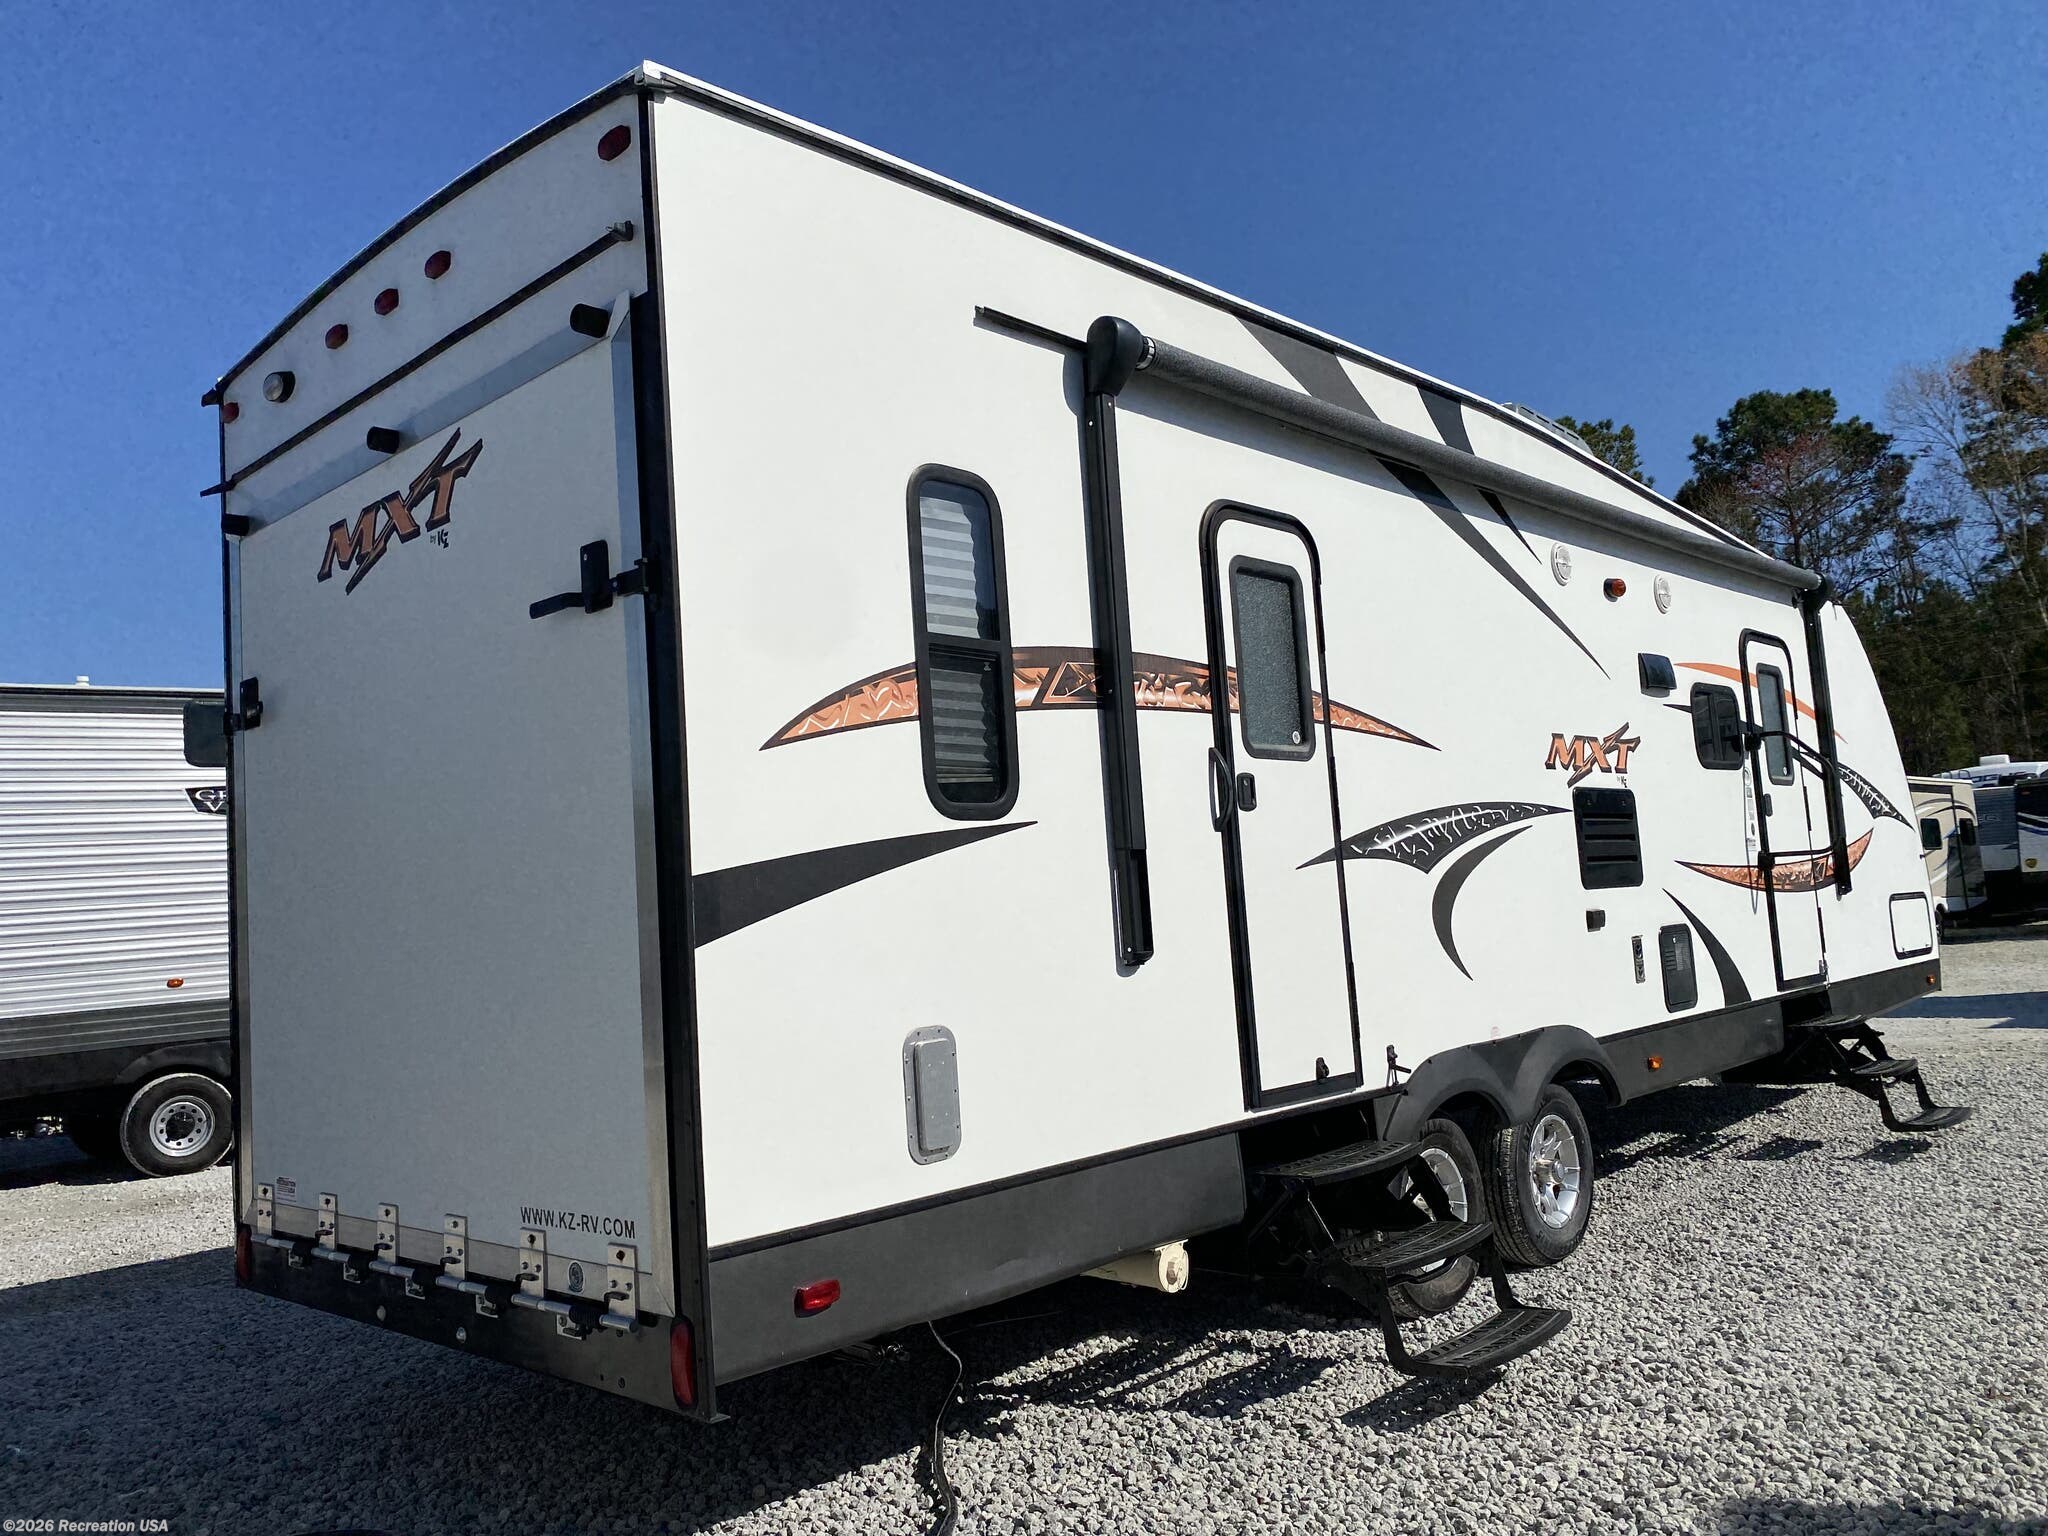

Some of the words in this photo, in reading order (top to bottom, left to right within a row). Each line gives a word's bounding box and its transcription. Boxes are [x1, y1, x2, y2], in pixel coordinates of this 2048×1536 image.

[317, 427, 484, 596] MXT
[1545, 722, 1641, 788] MXT
[520, 1206, 636, 1239] WWW.KZ-RV.COM
